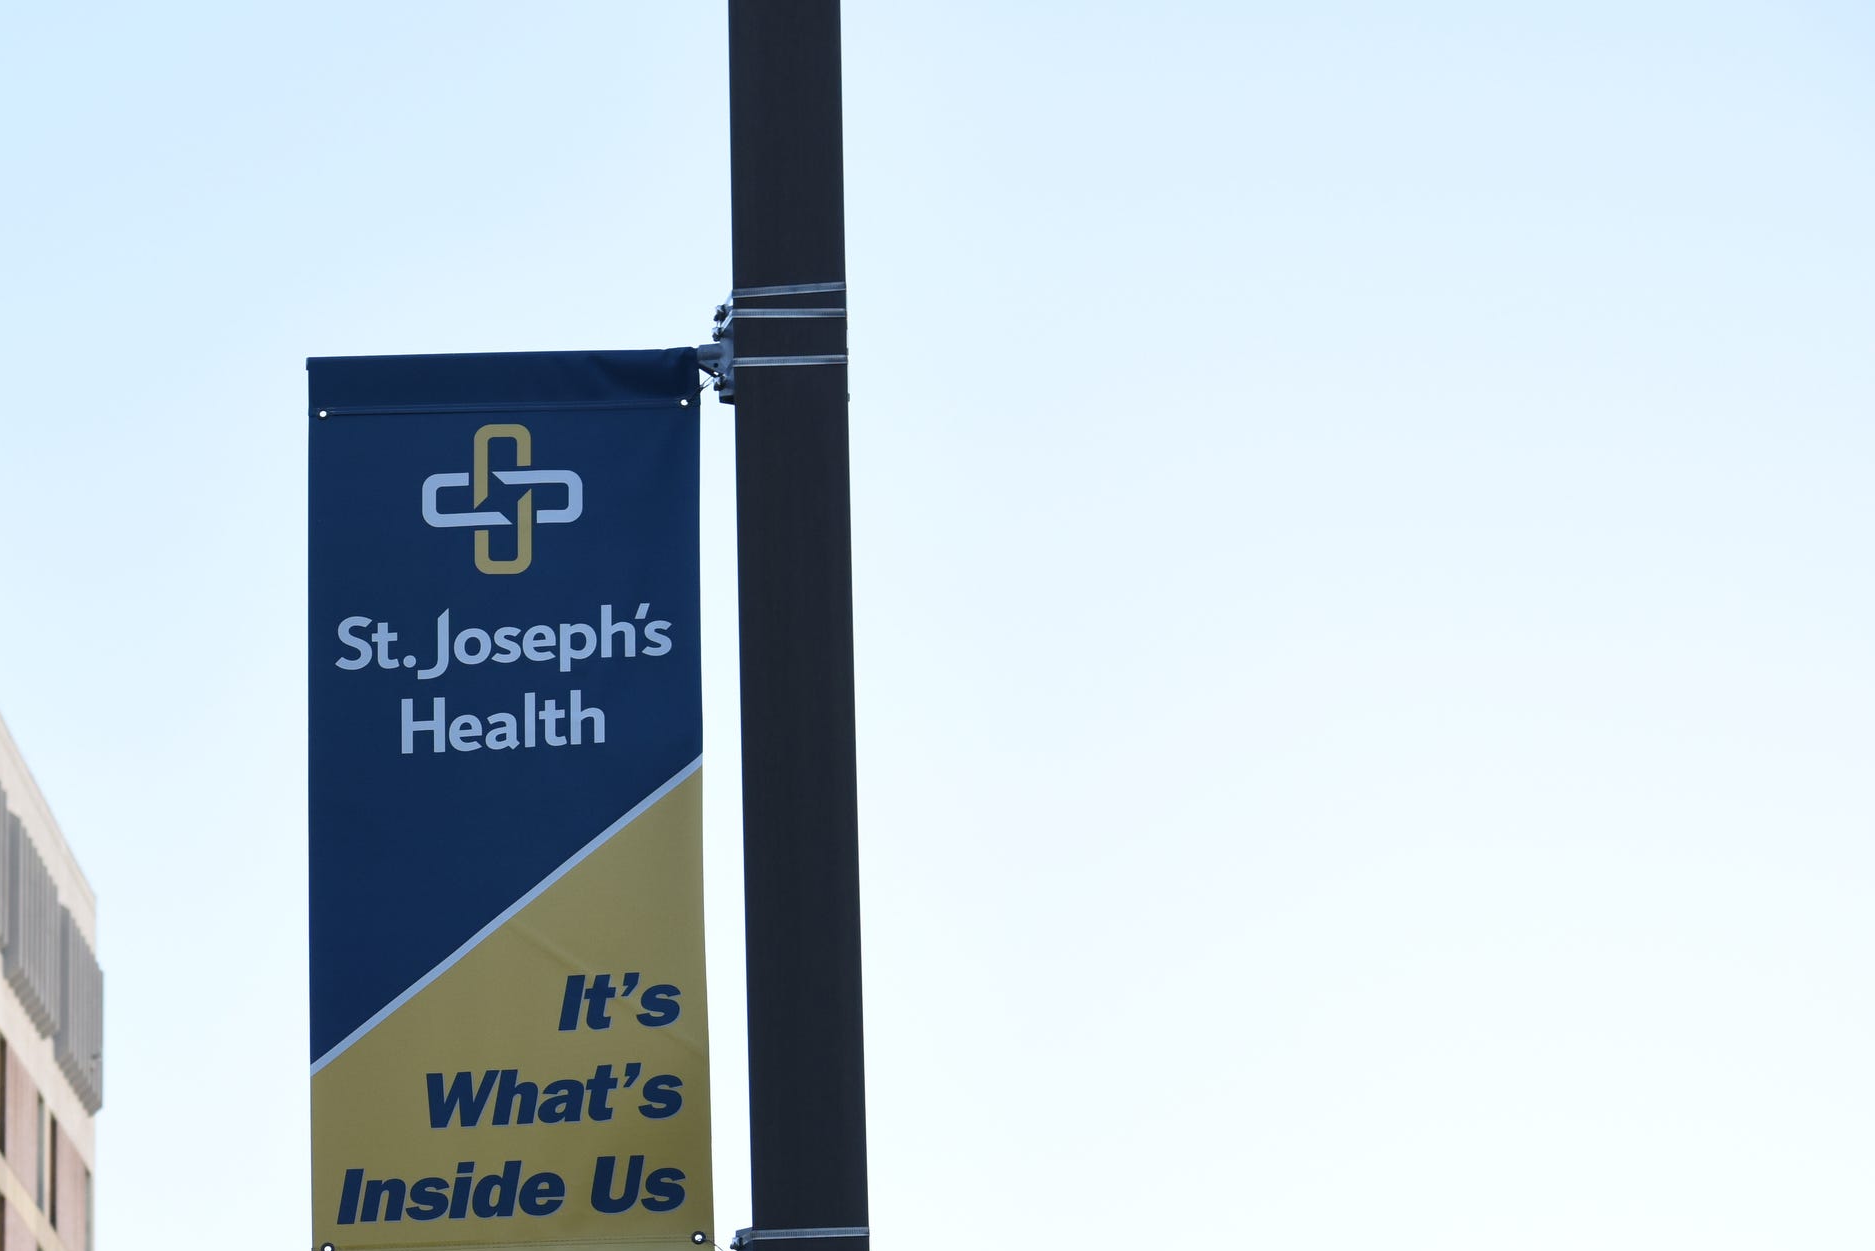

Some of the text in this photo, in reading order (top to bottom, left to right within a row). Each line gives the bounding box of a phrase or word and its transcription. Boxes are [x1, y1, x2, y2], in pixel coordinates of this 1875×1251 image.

[335, 603, 673, 680] St. Joseph's
[401, 690, 606, 754] Health
[558, 972, 681, 1031] It's
[426, 1062, 683, 1128] What's
[337, 1155, 686, 1225] Inside Us
